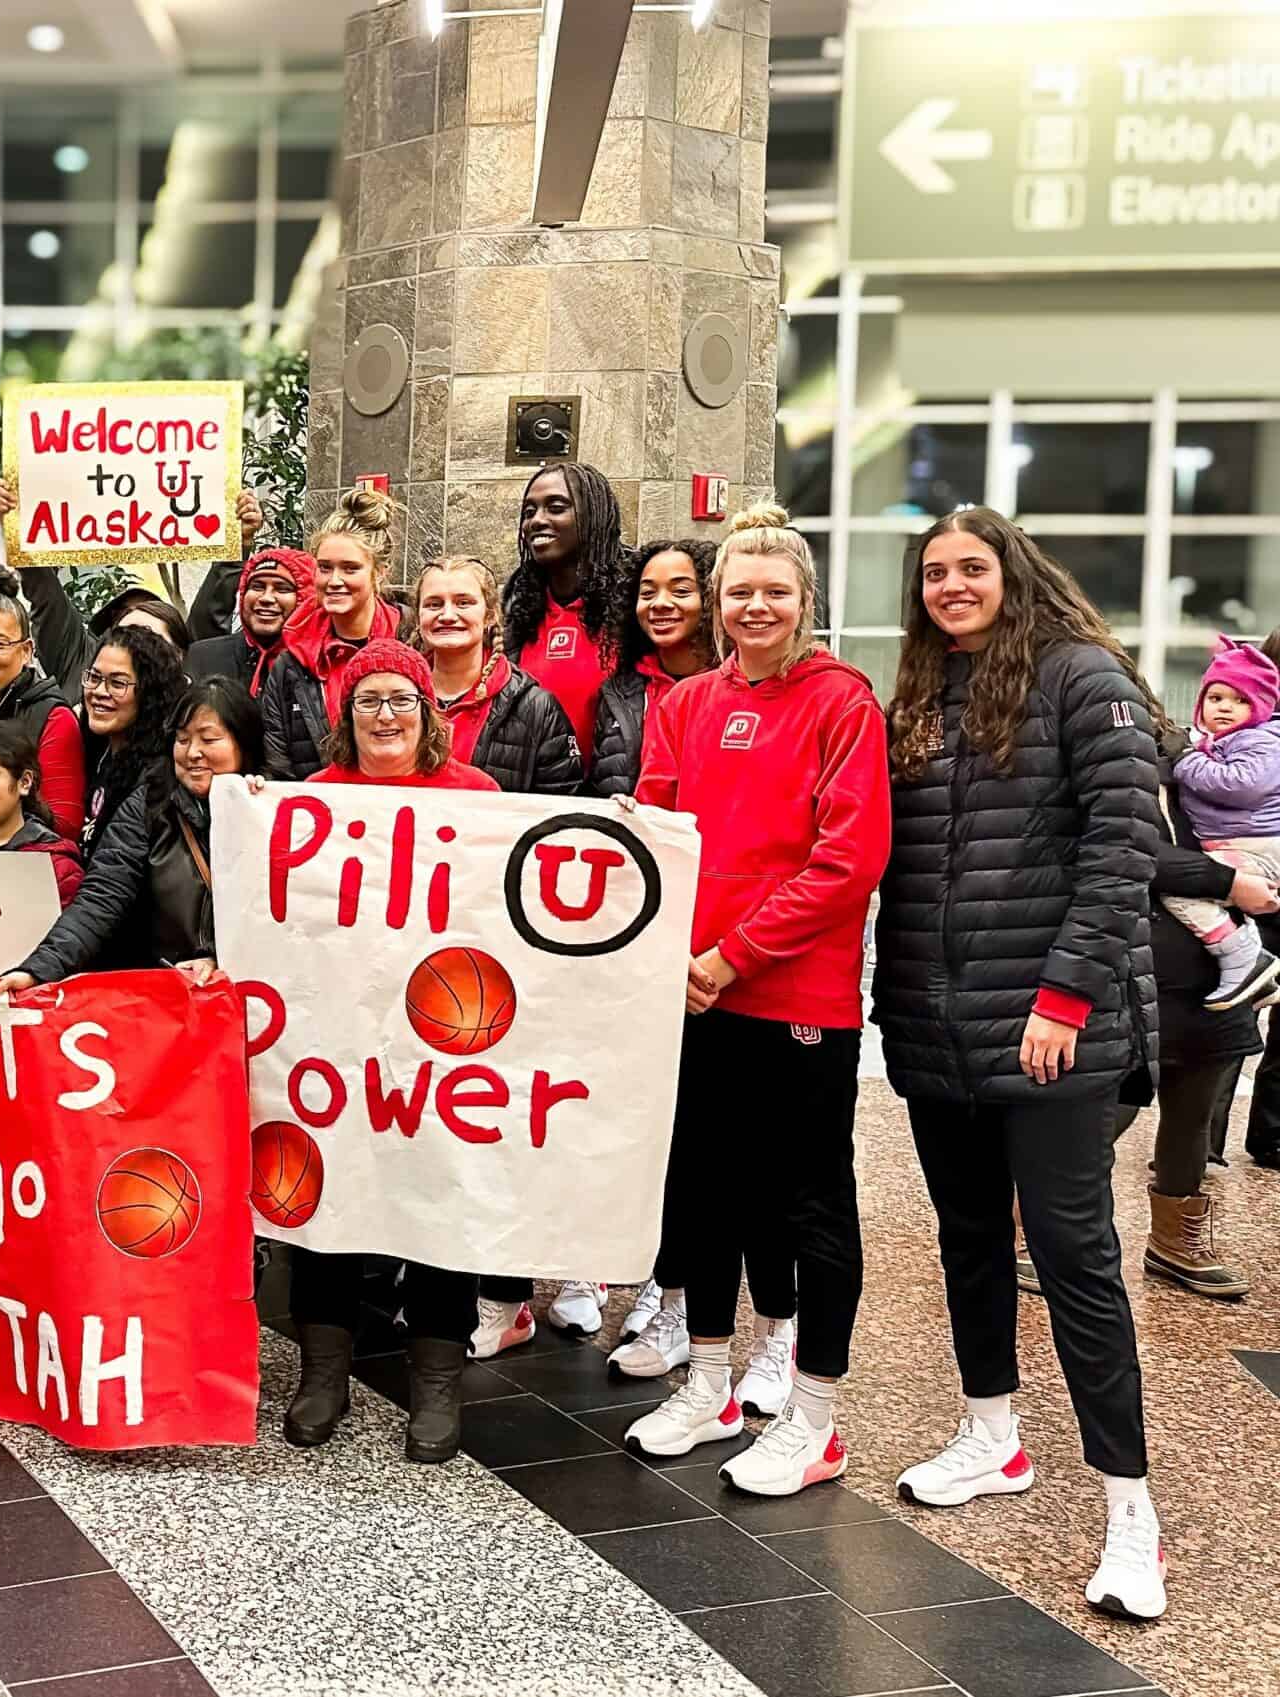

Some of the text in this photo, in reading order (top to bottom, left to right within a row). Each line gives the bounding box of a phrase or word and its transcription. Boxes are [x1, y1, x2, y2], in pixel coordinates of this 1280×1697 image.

[1114, 114, 1215, 164] Ride
[30, 406, 220, 455] Welcome
[87, 463, 136, 497] to
[26, 500, 190, 546] Alaska
[269, 795, 626, 933] Pili U
